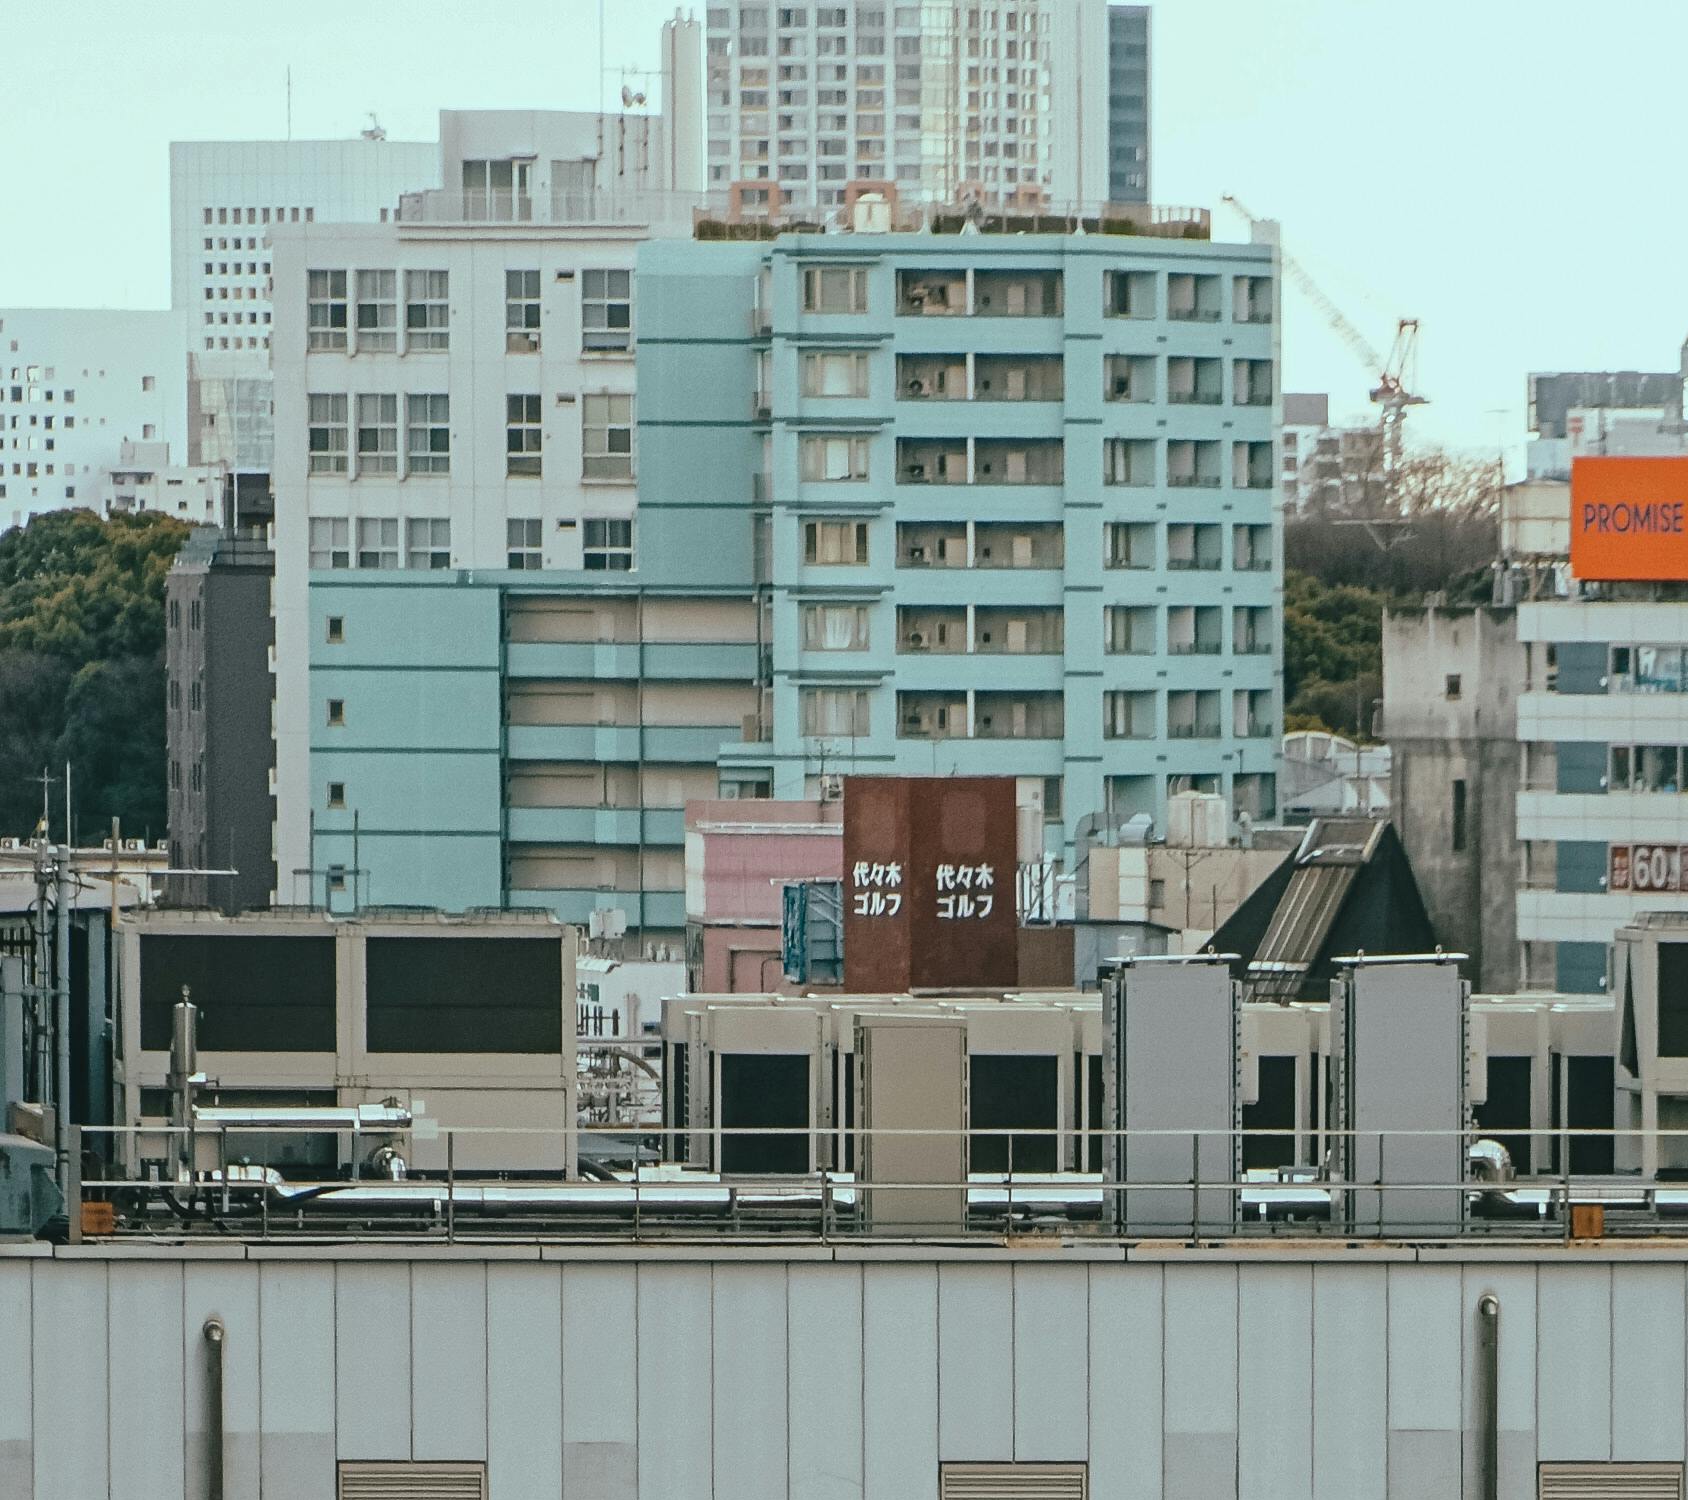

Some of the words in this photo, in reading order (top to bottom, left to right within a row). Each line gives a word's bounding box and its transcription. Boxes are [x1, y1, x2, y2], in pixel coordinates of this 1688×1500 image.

[1584, 503, 1684, 533] PROMISE
[853, 861, 901, 887] 代々木
[936, 863, 994, 891] 代々木
[853, 892, 901, 916] ゴルフ
[936, 895, 993, 919] ゴルフ
